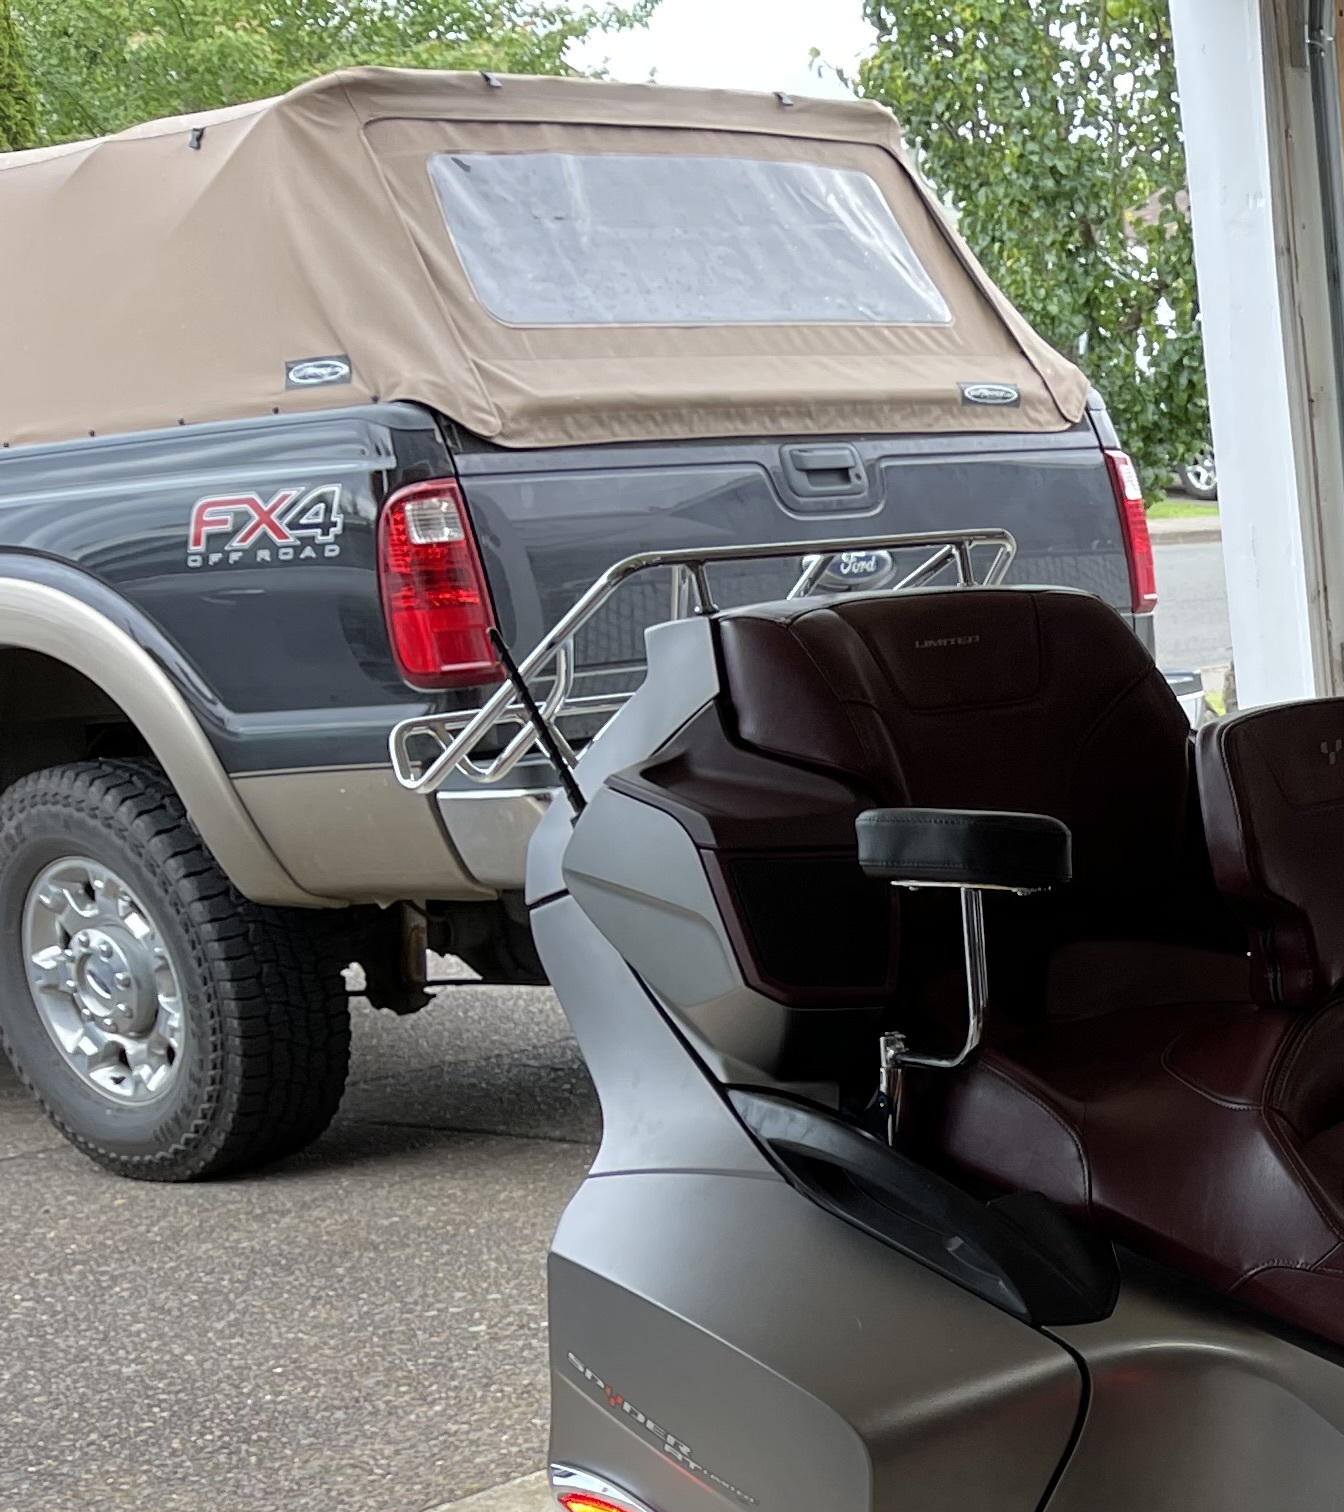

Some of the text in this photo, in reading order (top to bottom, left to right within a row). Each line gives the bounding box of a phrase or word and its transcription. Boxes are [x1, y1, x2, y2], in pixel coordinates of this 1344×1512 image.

[187, 483, 344, 553] FX4
[187, 545, 341, 568] OFF ROAD
[840, 551, 877, 575] Ford
